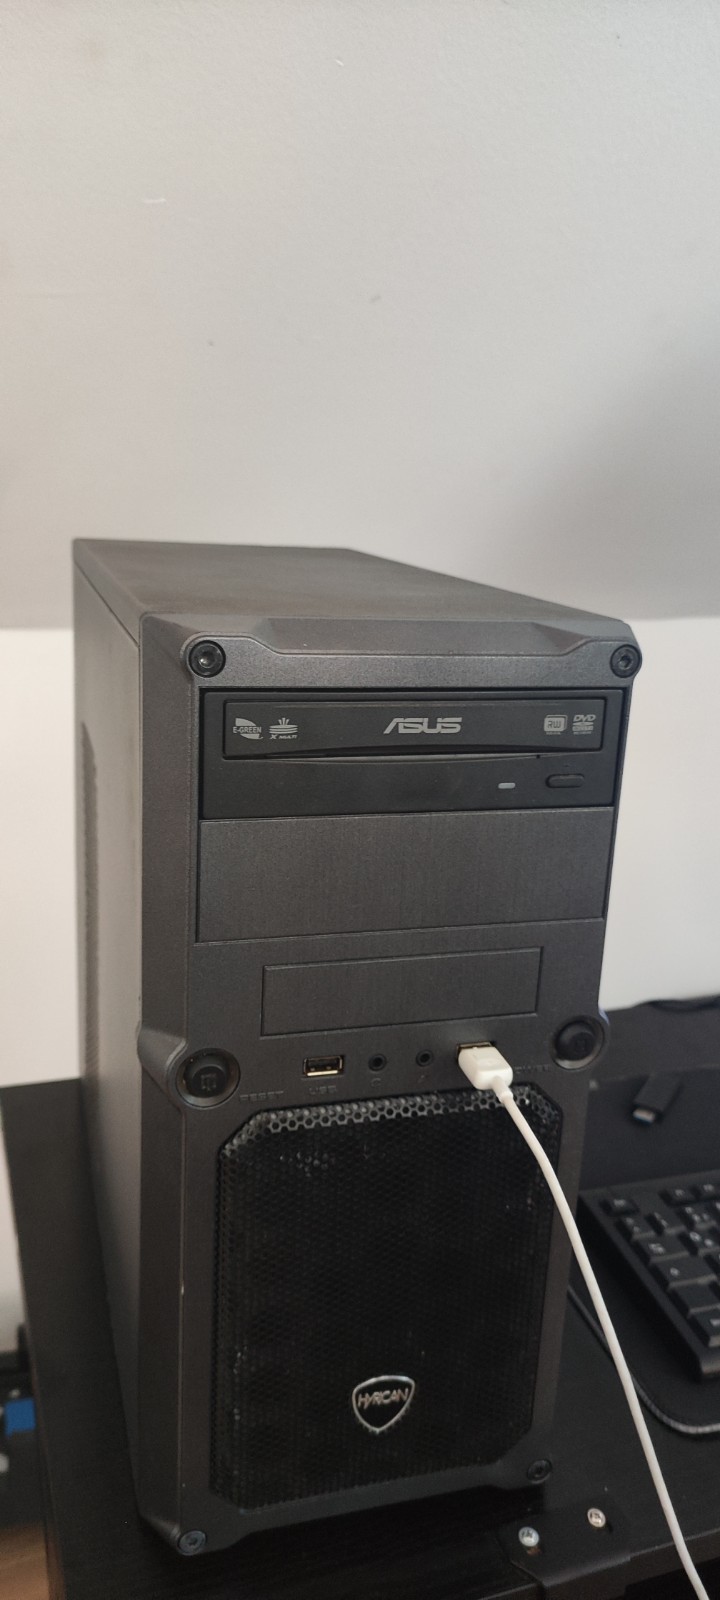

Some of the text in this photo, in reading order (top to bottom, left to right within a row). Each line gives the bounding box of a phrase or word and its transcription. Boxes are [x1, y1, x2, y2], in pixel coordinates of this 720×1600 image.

[573, 714, 597, 722] DVD
[232, 726, 262, 734] E-GREEN
[383, 717, 463, 735] ASUS
